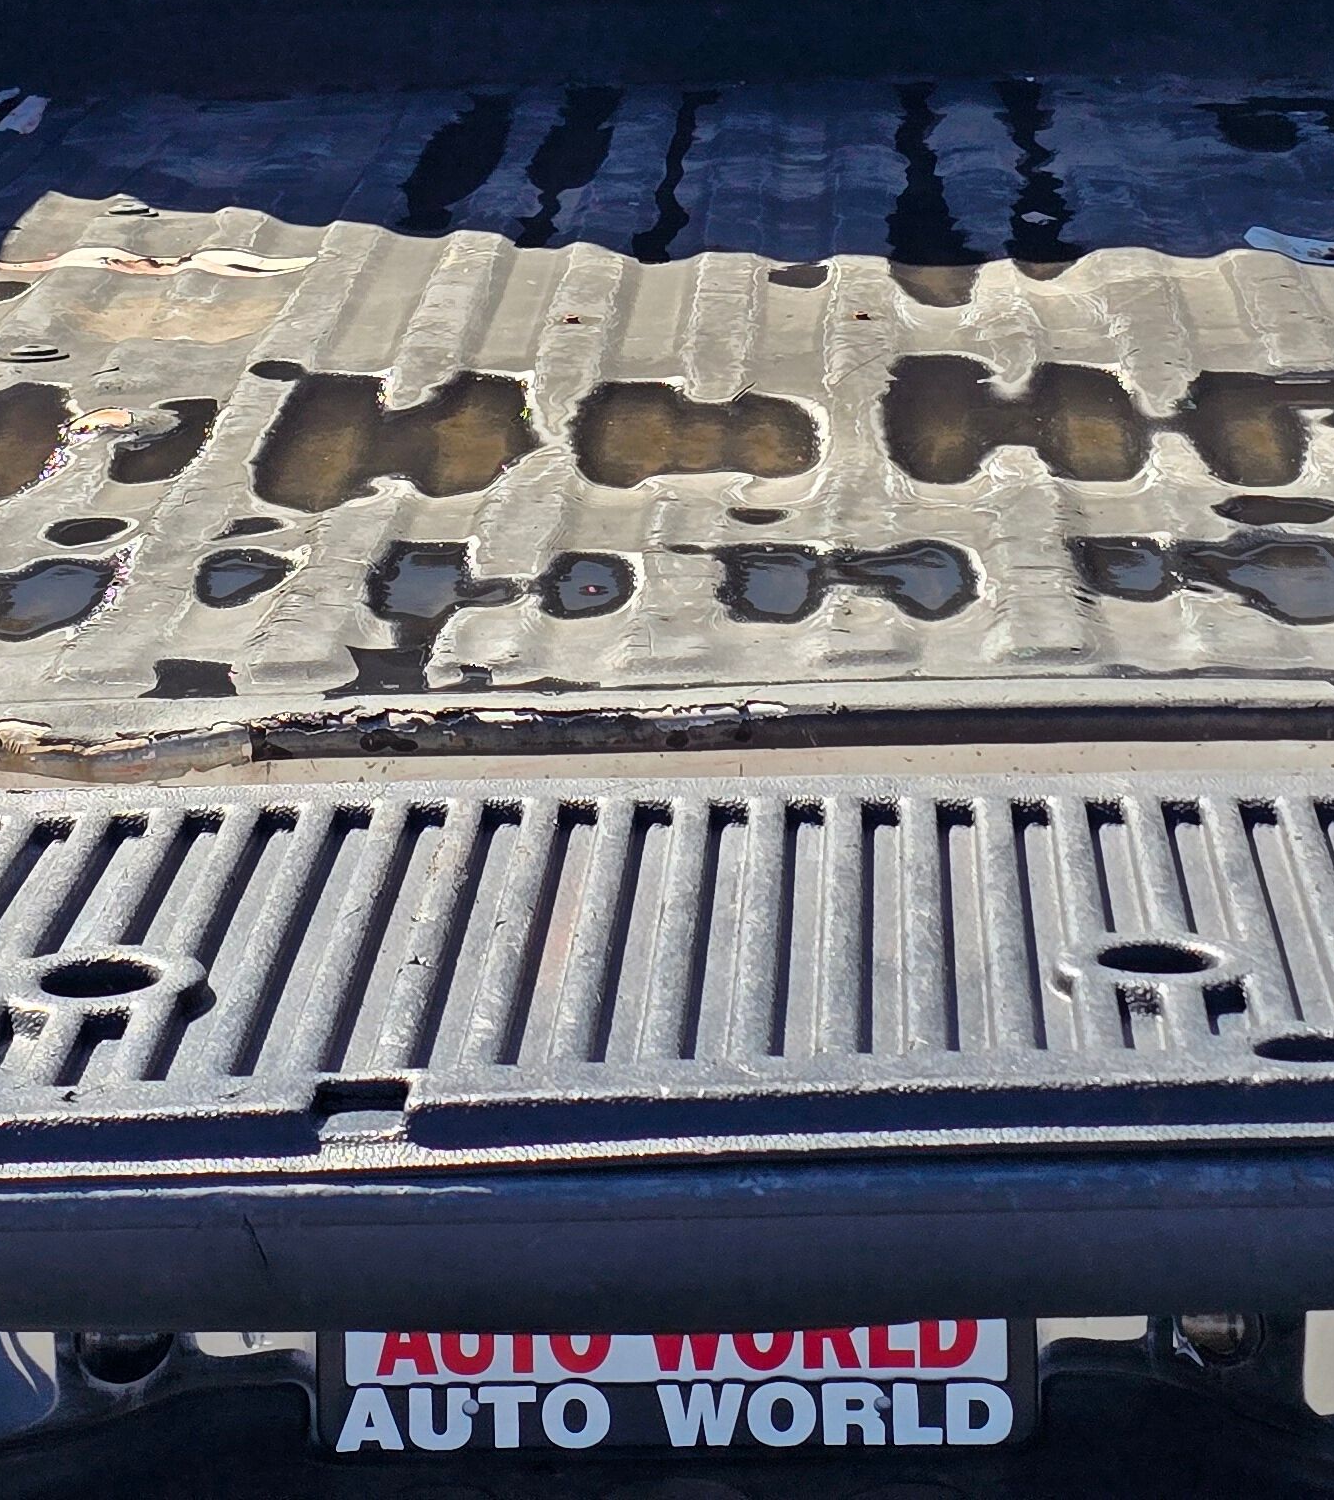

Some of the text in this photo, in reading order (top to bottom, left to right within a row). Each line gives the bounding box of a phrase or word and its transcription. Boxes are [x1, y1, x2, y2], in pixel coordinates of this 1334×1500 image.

[652, 1319, 978, 1372] WORLD
[335, 1381, 1014, 1452] AUTO WORLD
